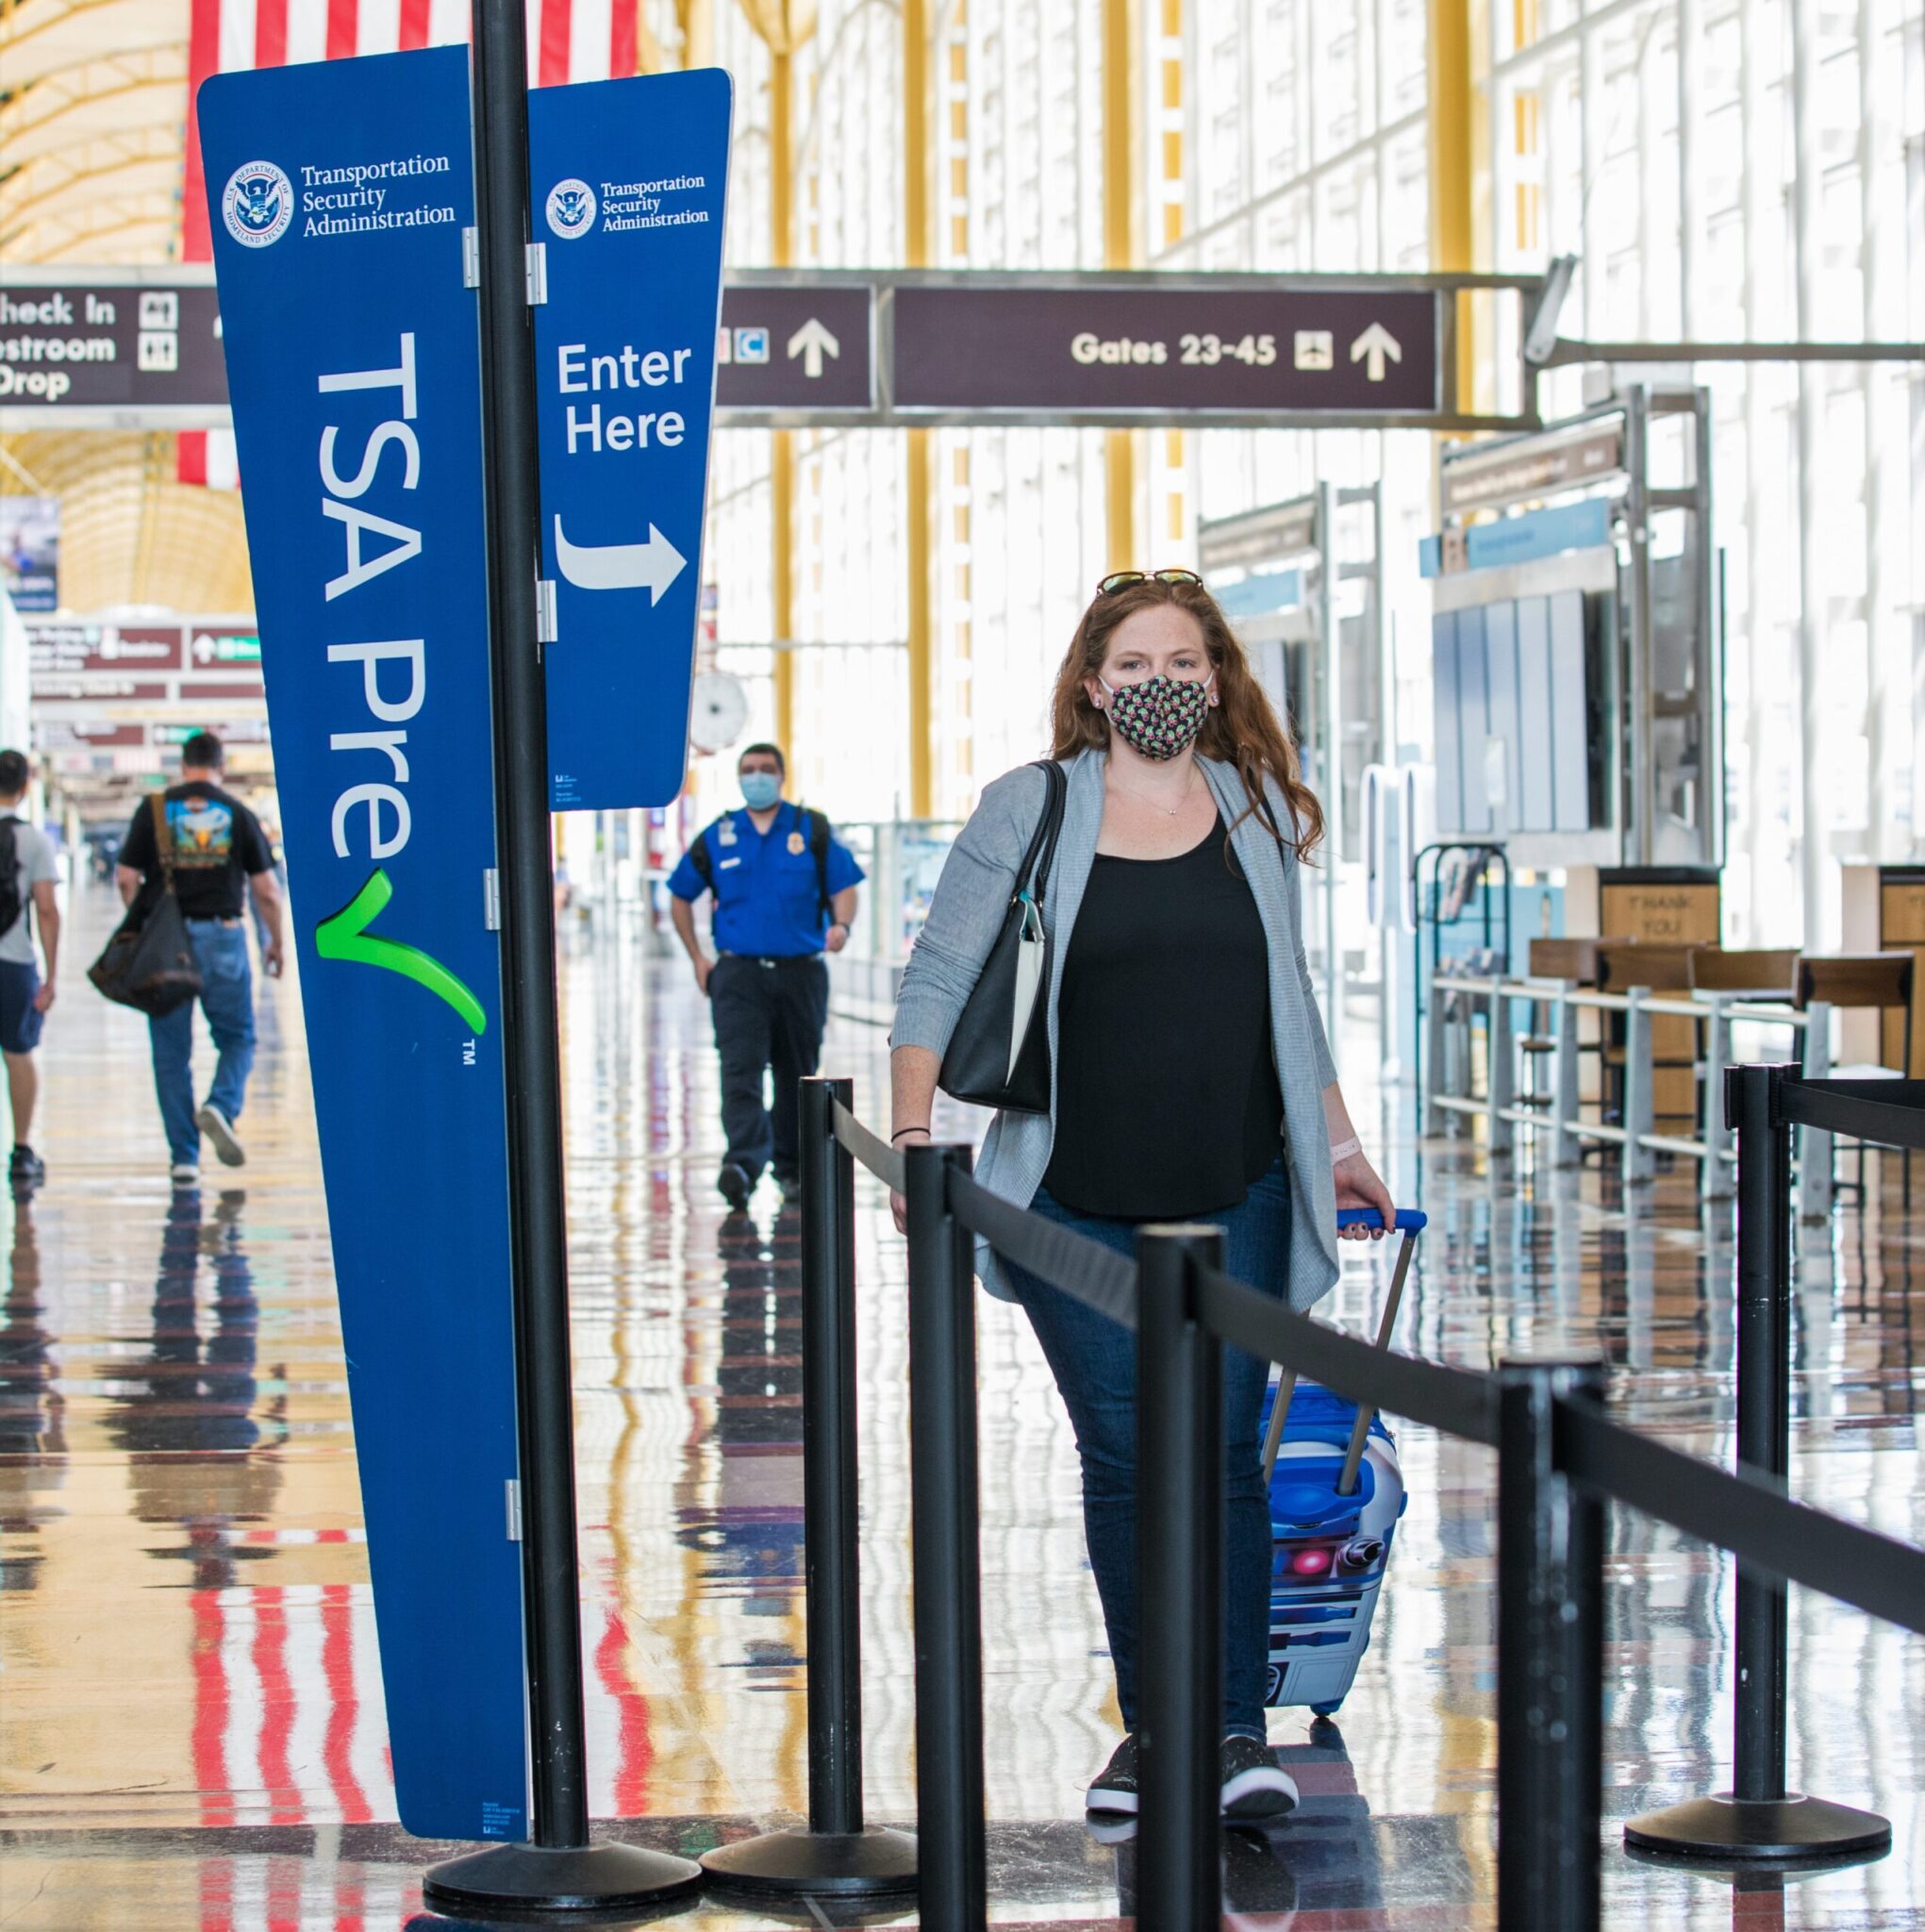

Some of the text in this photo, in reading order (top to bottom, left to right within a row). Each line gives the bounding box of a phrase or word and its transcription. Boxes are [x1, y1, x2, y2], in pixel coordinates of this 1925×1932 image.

[236, 165, 284, 182] DEPARTMENT
[281, 183, 290, 194] OF
[301, 155, 450, 188] Transportation
[601, 175, 705, 198] Transportation
[303, 187, 387, 212] Security
[602, 197, 661, 215] Security
[226, 205, 290, 243] HOMELAND SECURITY
[303, 205, 456, 237] Administration
[603, 209, 709, 232] Administration
[0, 291, 116, 325] heck In
[1070, 332, 1277, 365] Gates 23-45
[558, 343, 692, 393] Enter
[566, 404, 685, 454] Here
[318, 331, 476, 1065] TSA Pre TM
[1629, 893, 1694, 910] THANK
[1642, 918, 1683, 935] YOU
